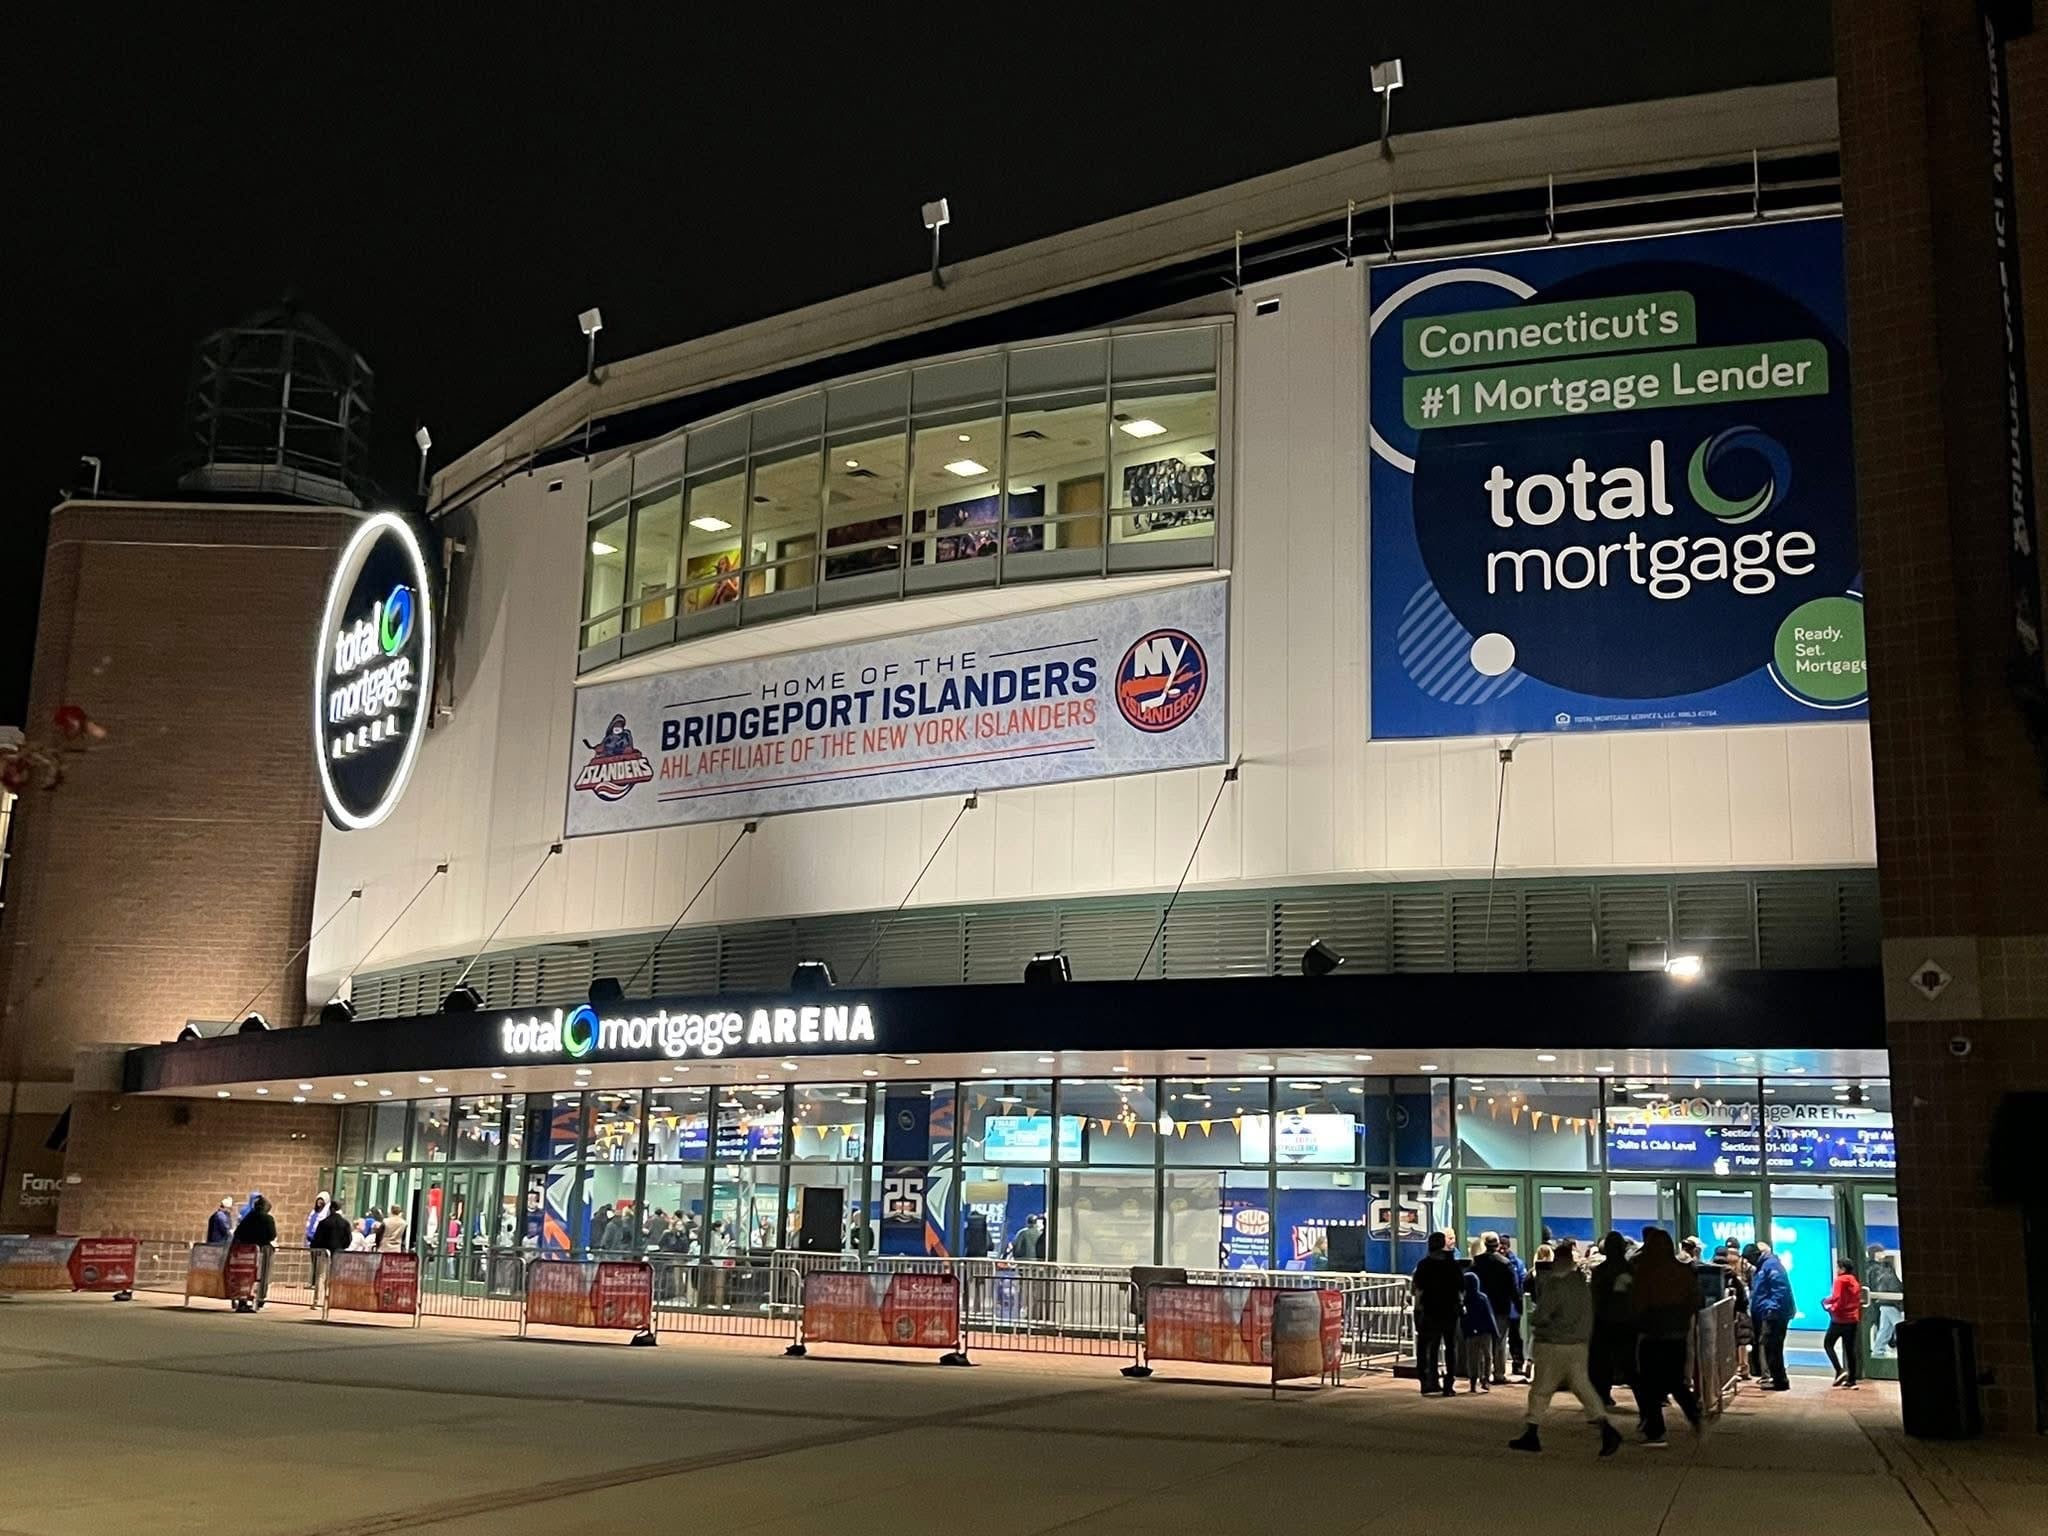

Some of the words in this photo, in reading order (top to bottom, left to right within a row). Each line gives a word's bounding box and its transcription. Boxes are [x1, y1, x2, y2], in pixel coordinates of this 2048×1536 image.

[1419, 302, 1680, 360] Connecticut's
[1421, 382, 1462, 420] #1
[1474, 371, 1660, 413] Mortgage
[1673, 354, 1812, 396] Lender
[1484, 439, 1674, 528] total
[1487, 529, 1817, 601] mortgage
[335, 600, 382, 675] total
[1134, 637, 1189, 678] NY
[1793, 625, 1844, 642] Ready.
[1794, 643, 1826, 657] Set.
[329, 656, 413, 724] mortgage
[761, 672, 846, 701] HOME
[860, 663, 899, 685] OF
[914, 651, 977, 676] THE
[660, 689, 875, 752] BRIDGEPORT
[882, 656, 1098, 721] ISLANDERS
[1124, 683, 1198, 724] ISLANDERS
[659, 754, 693, 781] AHL
[697, 741, 785, 775] AFFILIATE
[791, 736, 815, 763] OF
[820, 730, 857, 759] THE
[863, 723, 908, 754] NEW
[914, 714, 969, 748] YORK
[975, 698, 1097, 740] ISLANDERS
[575, 758, 652, 786] ISLANDERS
[502, 1008, 563, 1054] total
[598, 1009, 744, 1058] mortgage
[748, 1004, 876, 1044] ARENA
[1652, 1099, 1689, 1118] ttal
[1765, 1143, 1799, 1153] 01-108
[1766, 1157, 1794, 1166] ccess
[883, 1178, 924, 1220] 25
[1369, 1183, 1429, 1233] 25
